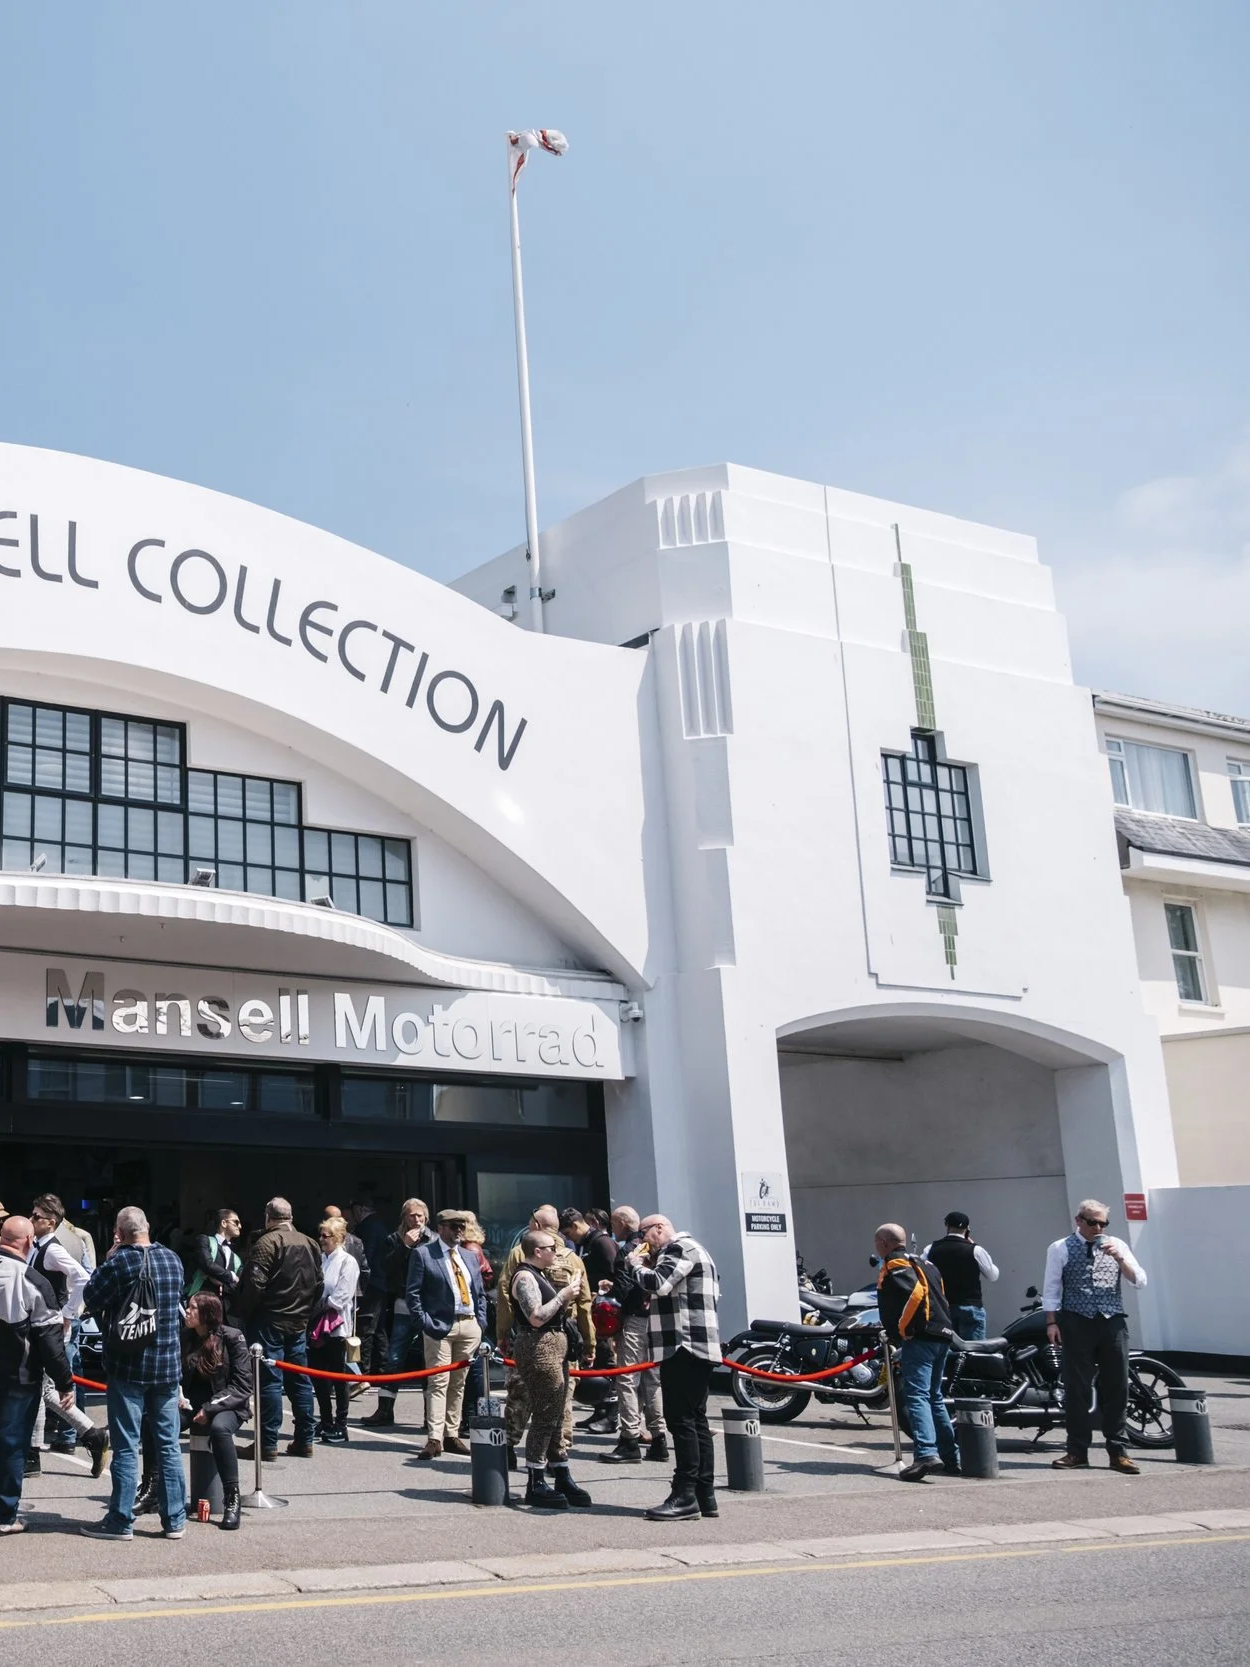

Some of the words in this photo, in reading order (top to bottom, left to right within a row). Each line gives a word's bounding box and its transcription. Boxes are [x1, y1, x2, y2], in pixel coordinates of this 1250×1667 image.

[127, 538, 529, 771] COLLECTION
[46, 967, 309, 1046] Mansell
[334, 992, 604, 1068] Motorrad
[750, 1223, 770, 1231] PARKING
[770, 1223, 782, 1231] ONLY
[751, 1215, 780, 1223] MOTORCYCLE
[120, 1315, 156, 1340] TENTH
